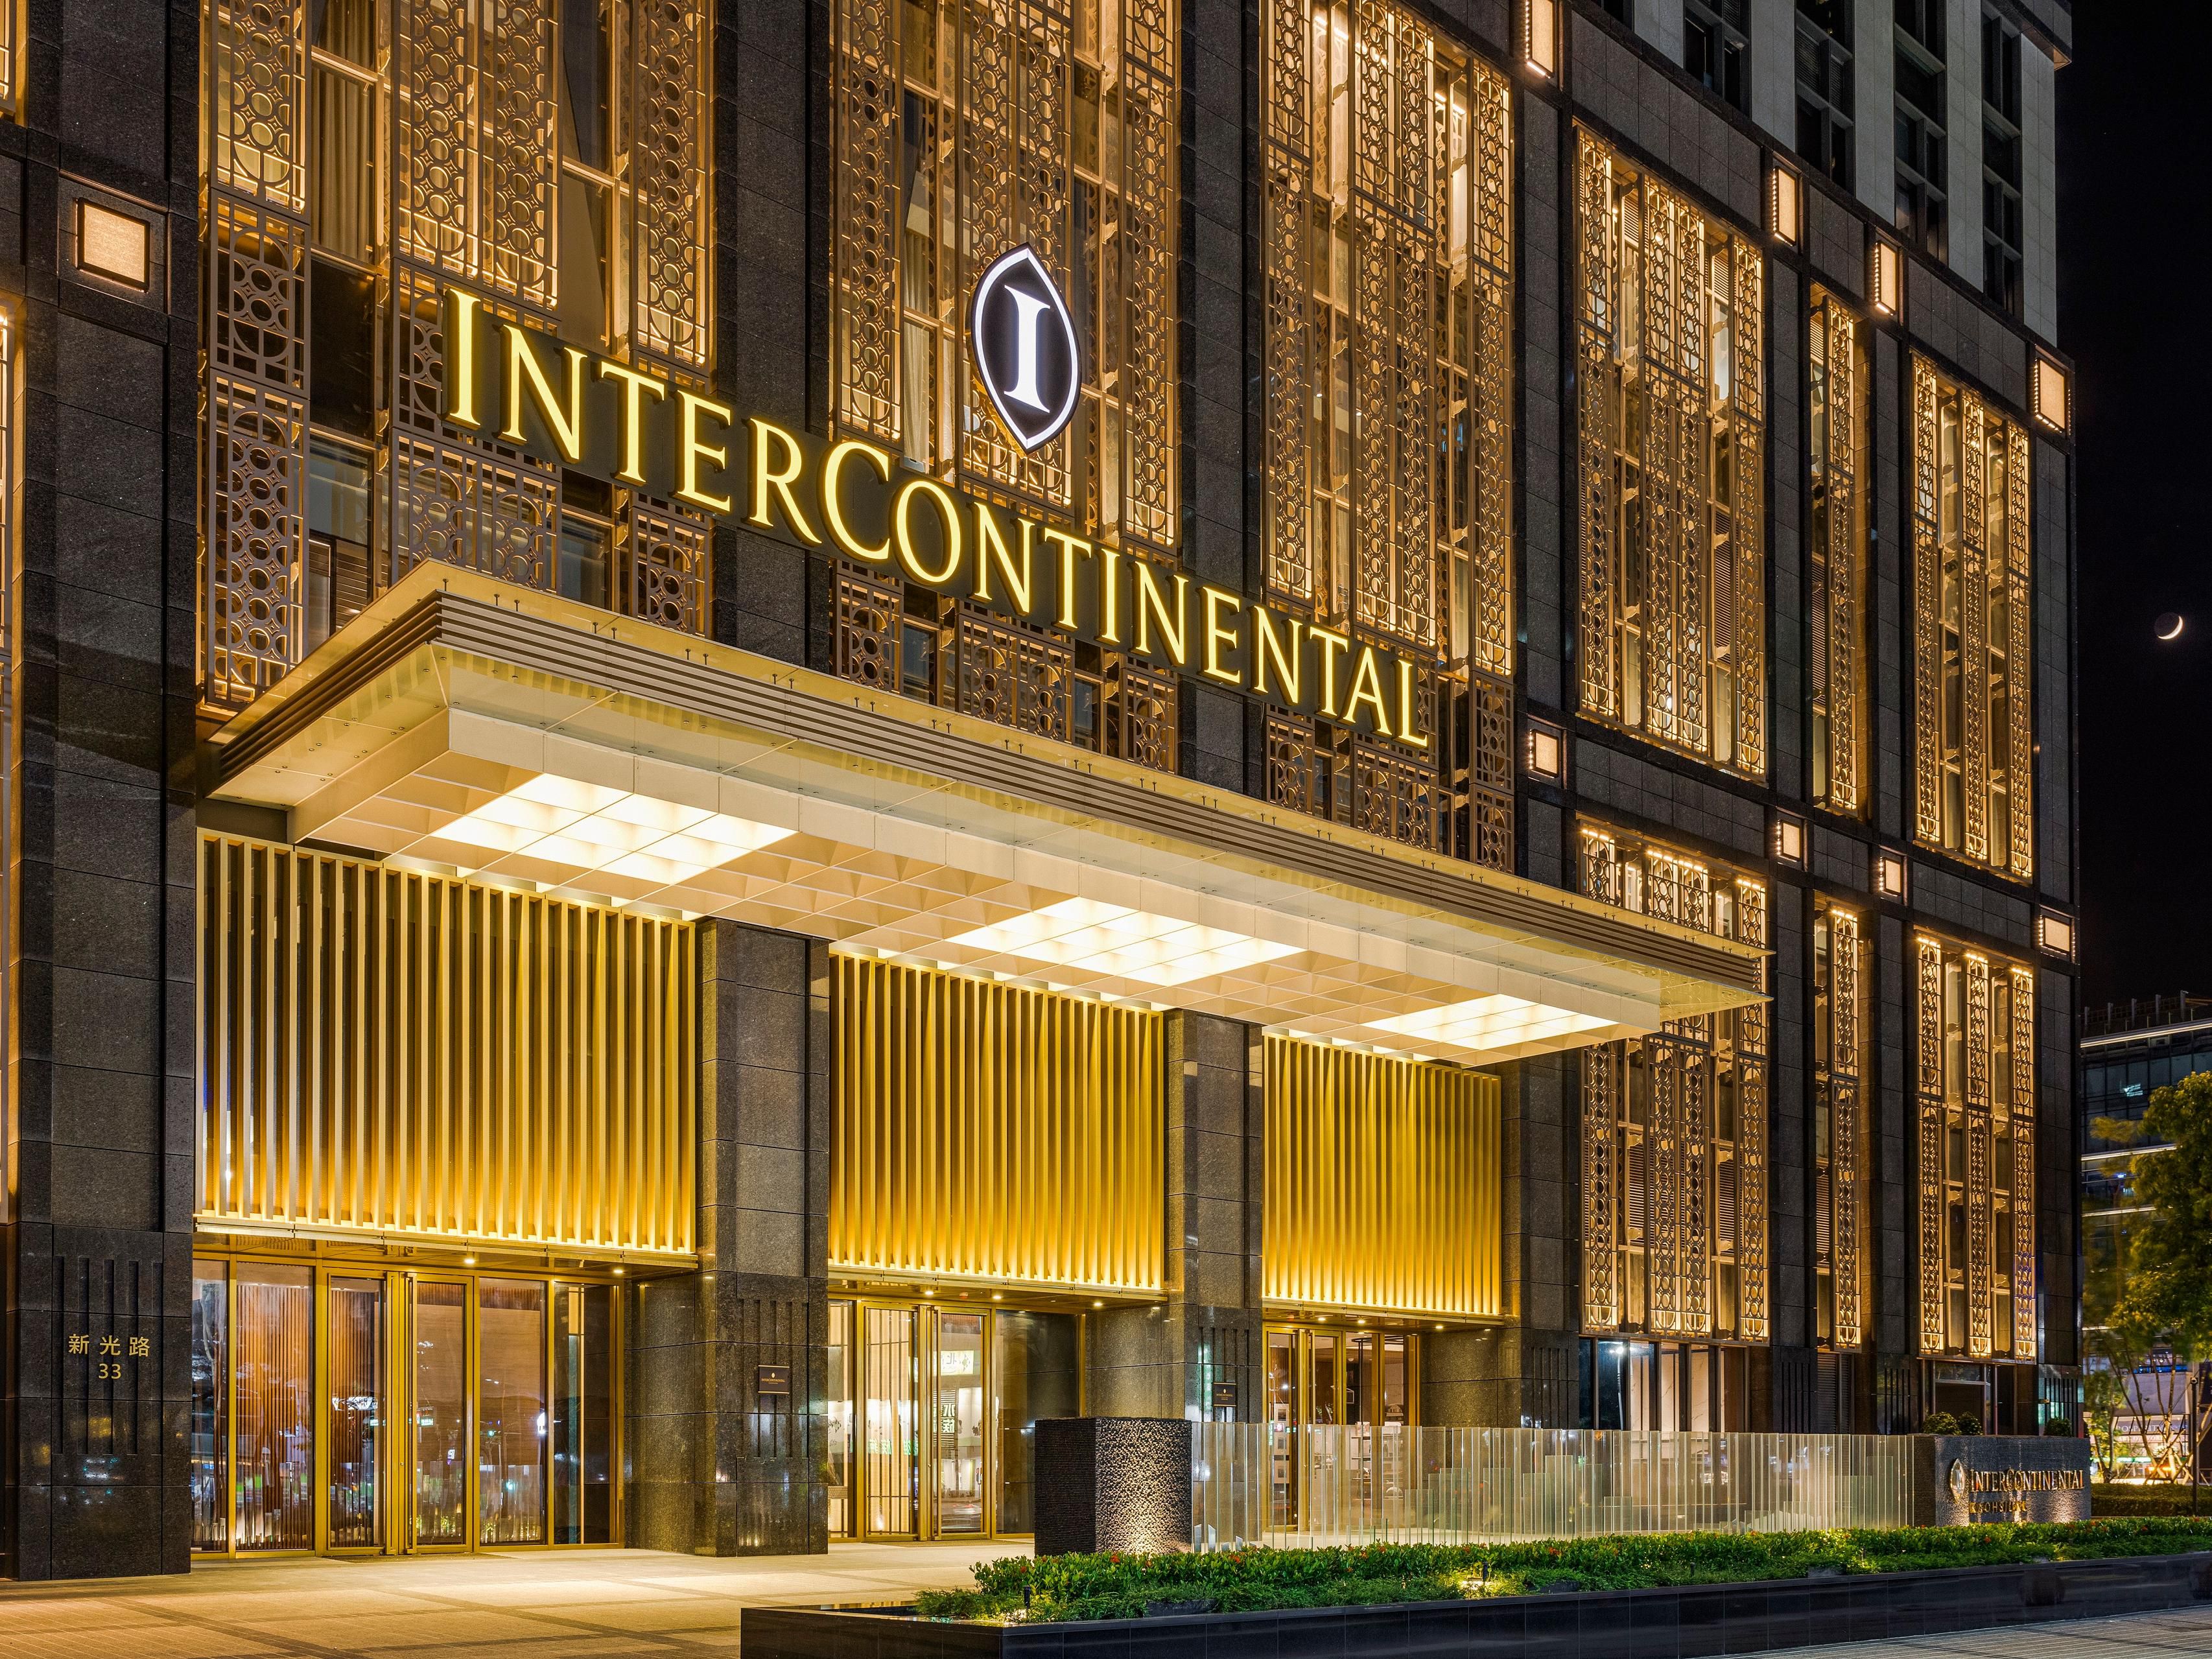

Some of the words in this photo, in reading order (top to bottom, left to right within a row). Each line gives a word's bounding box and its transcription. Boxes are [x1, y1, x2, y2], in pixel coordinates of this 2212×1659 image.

[446, 288, 1429, 747] INTERCONTINENTAL
[67, 1333, 151, 1358] 新光路
[97, 1363, 122, 1380] 33
[1970, 1468, 2086, 1492] INTERCONTINENTAL
